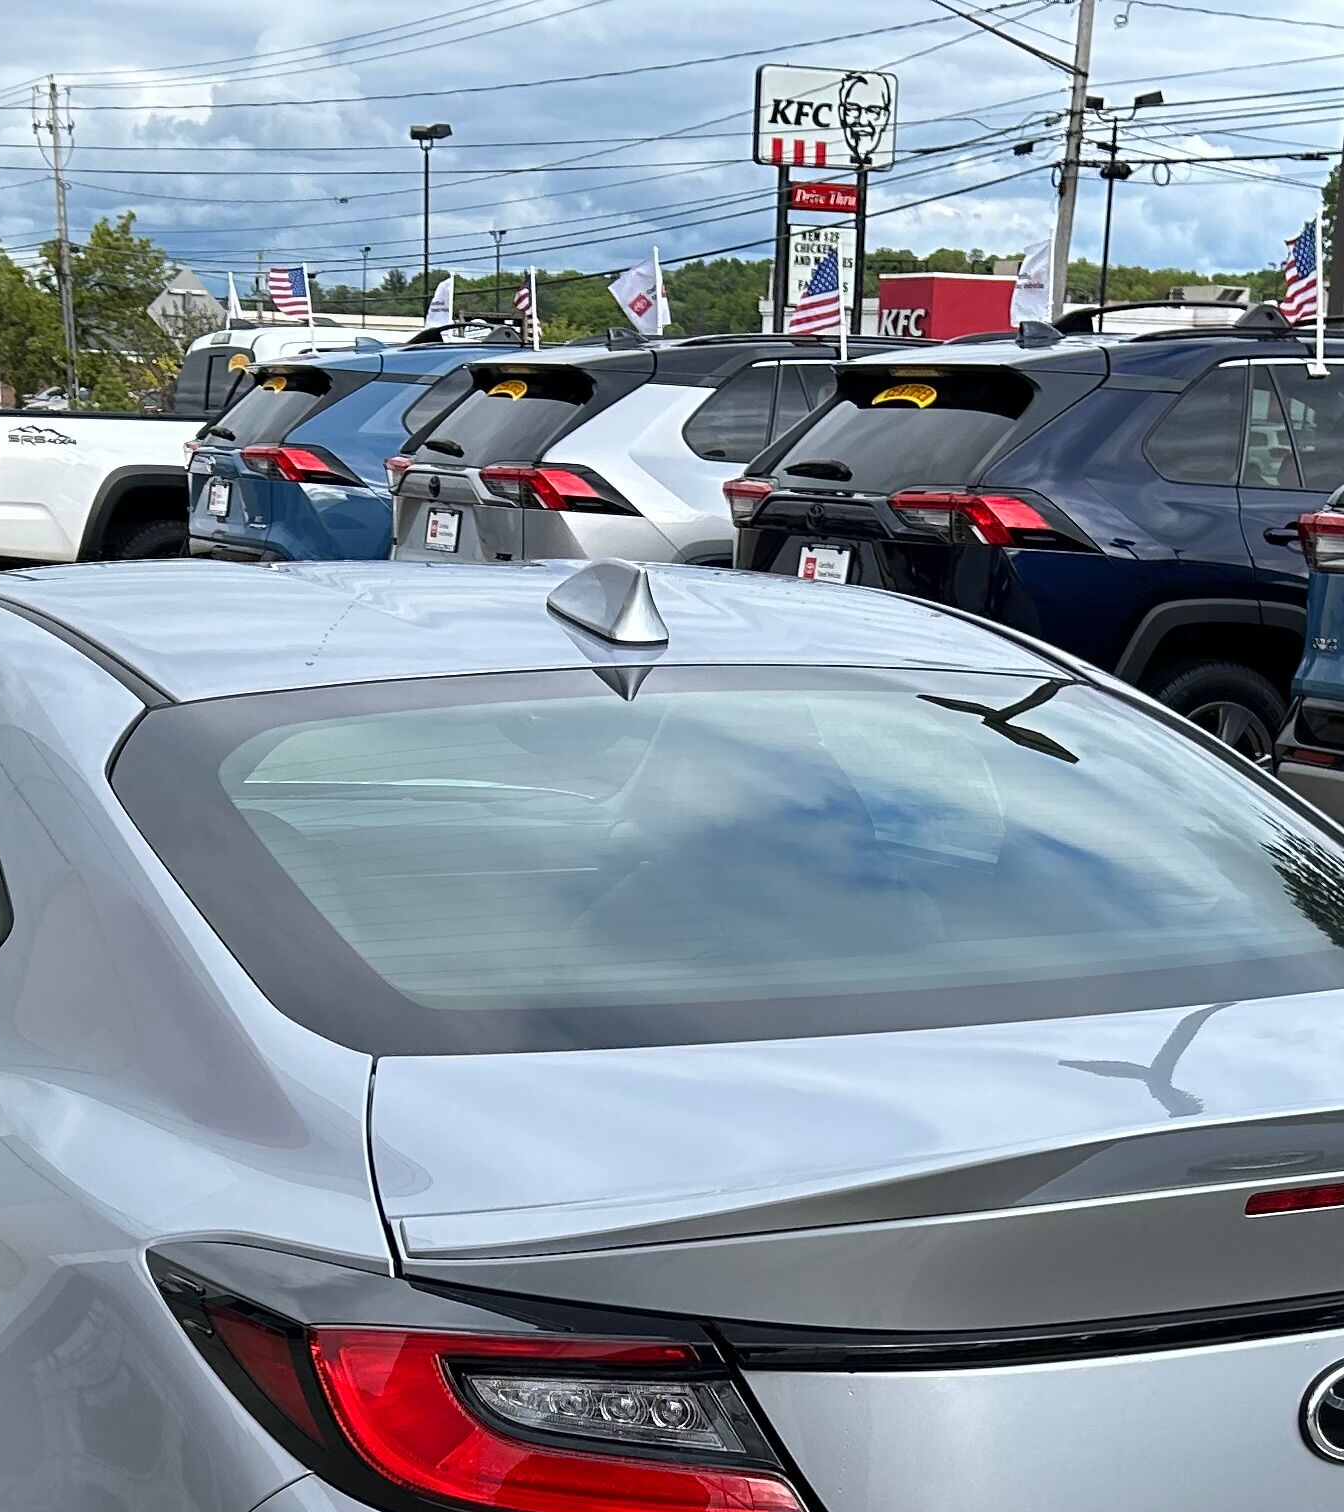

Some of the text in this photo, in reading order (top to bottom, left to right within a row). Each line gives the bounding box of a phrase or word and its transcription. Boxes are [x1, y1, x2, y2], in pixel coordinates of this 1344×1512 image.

[768, 98, 833, 128] KFC
[795, 188, 857, 206] Drive Thru
[879, 309, 926, 337] KFC
